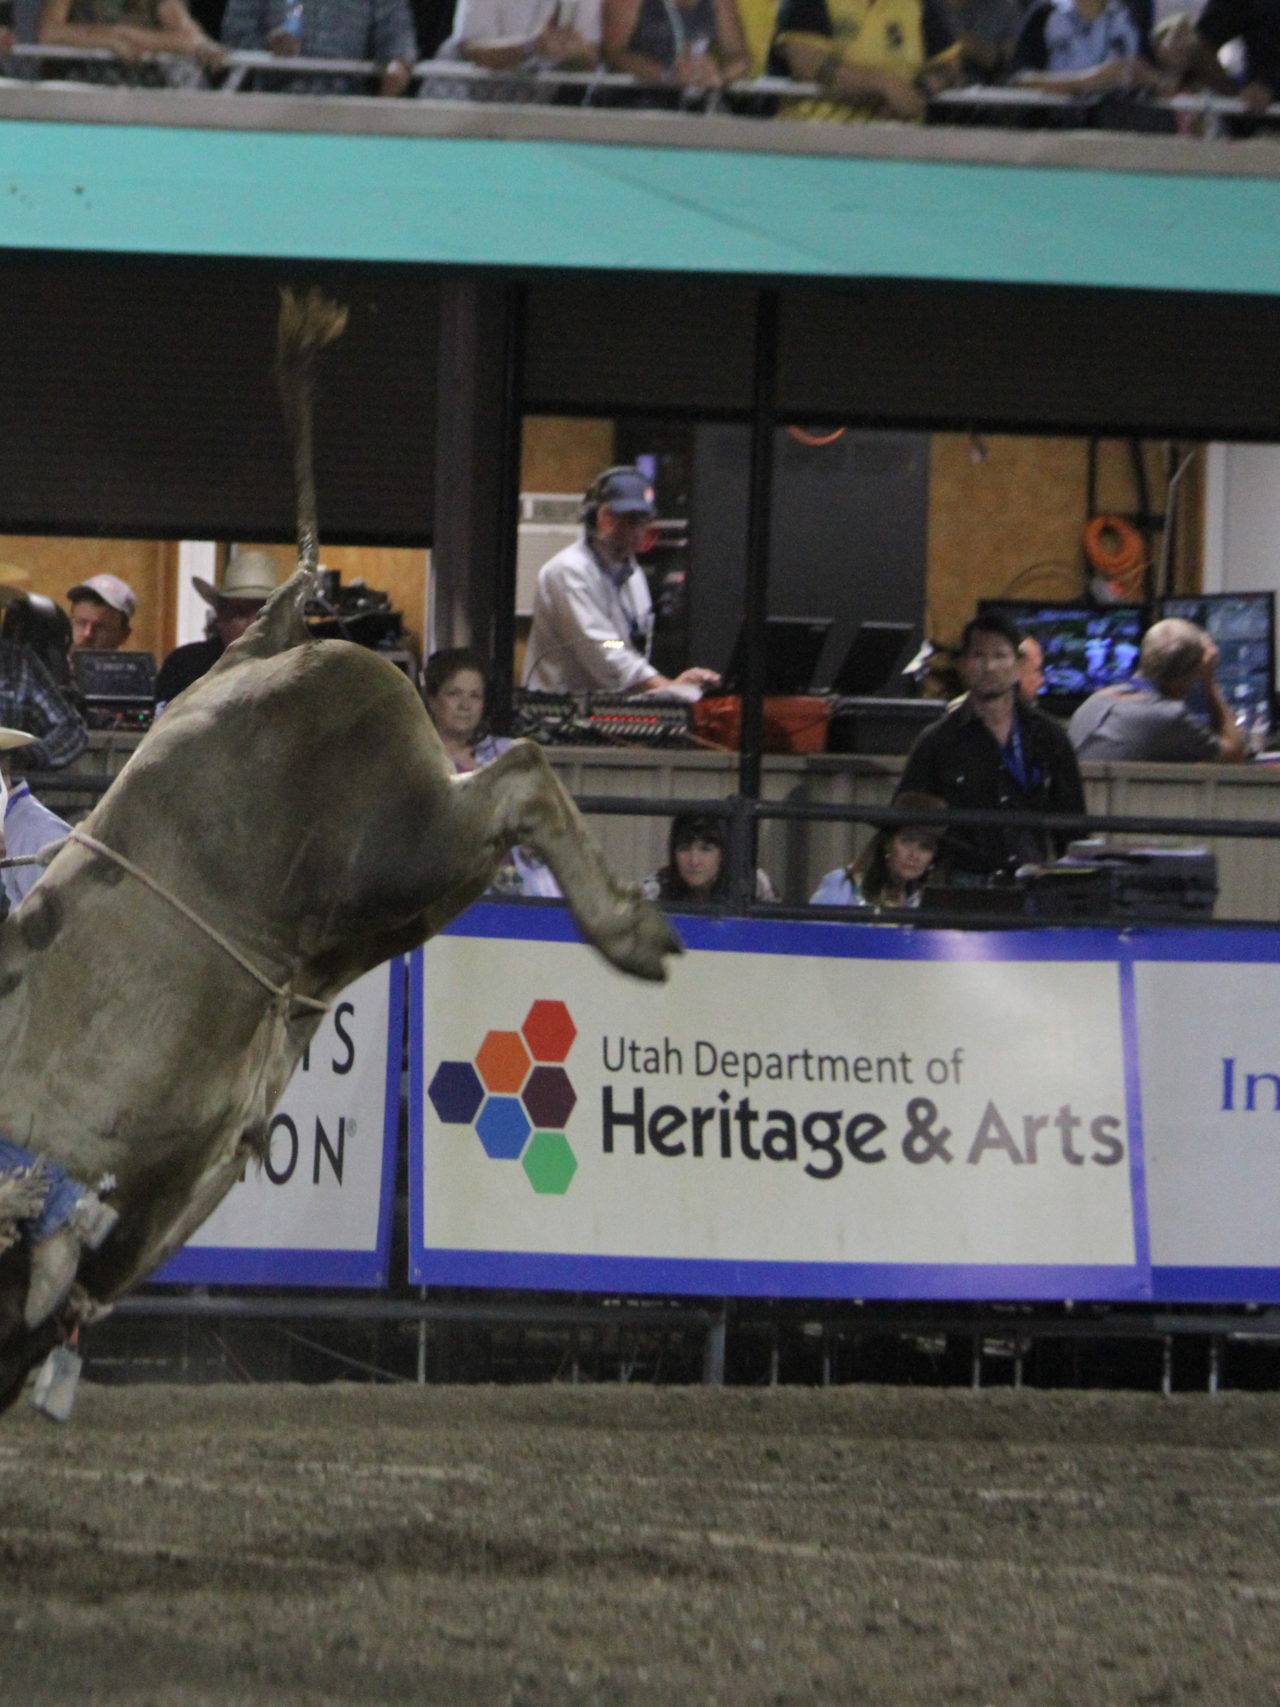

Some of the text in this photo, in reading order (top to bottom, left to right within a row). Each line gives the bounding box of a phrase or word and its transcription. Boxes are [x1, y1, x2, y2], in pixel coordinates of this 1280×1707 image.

[603, 1036, 964, 1087] Utah Department of
[603, 1085, 1124, 1180] Heritage & Arts
